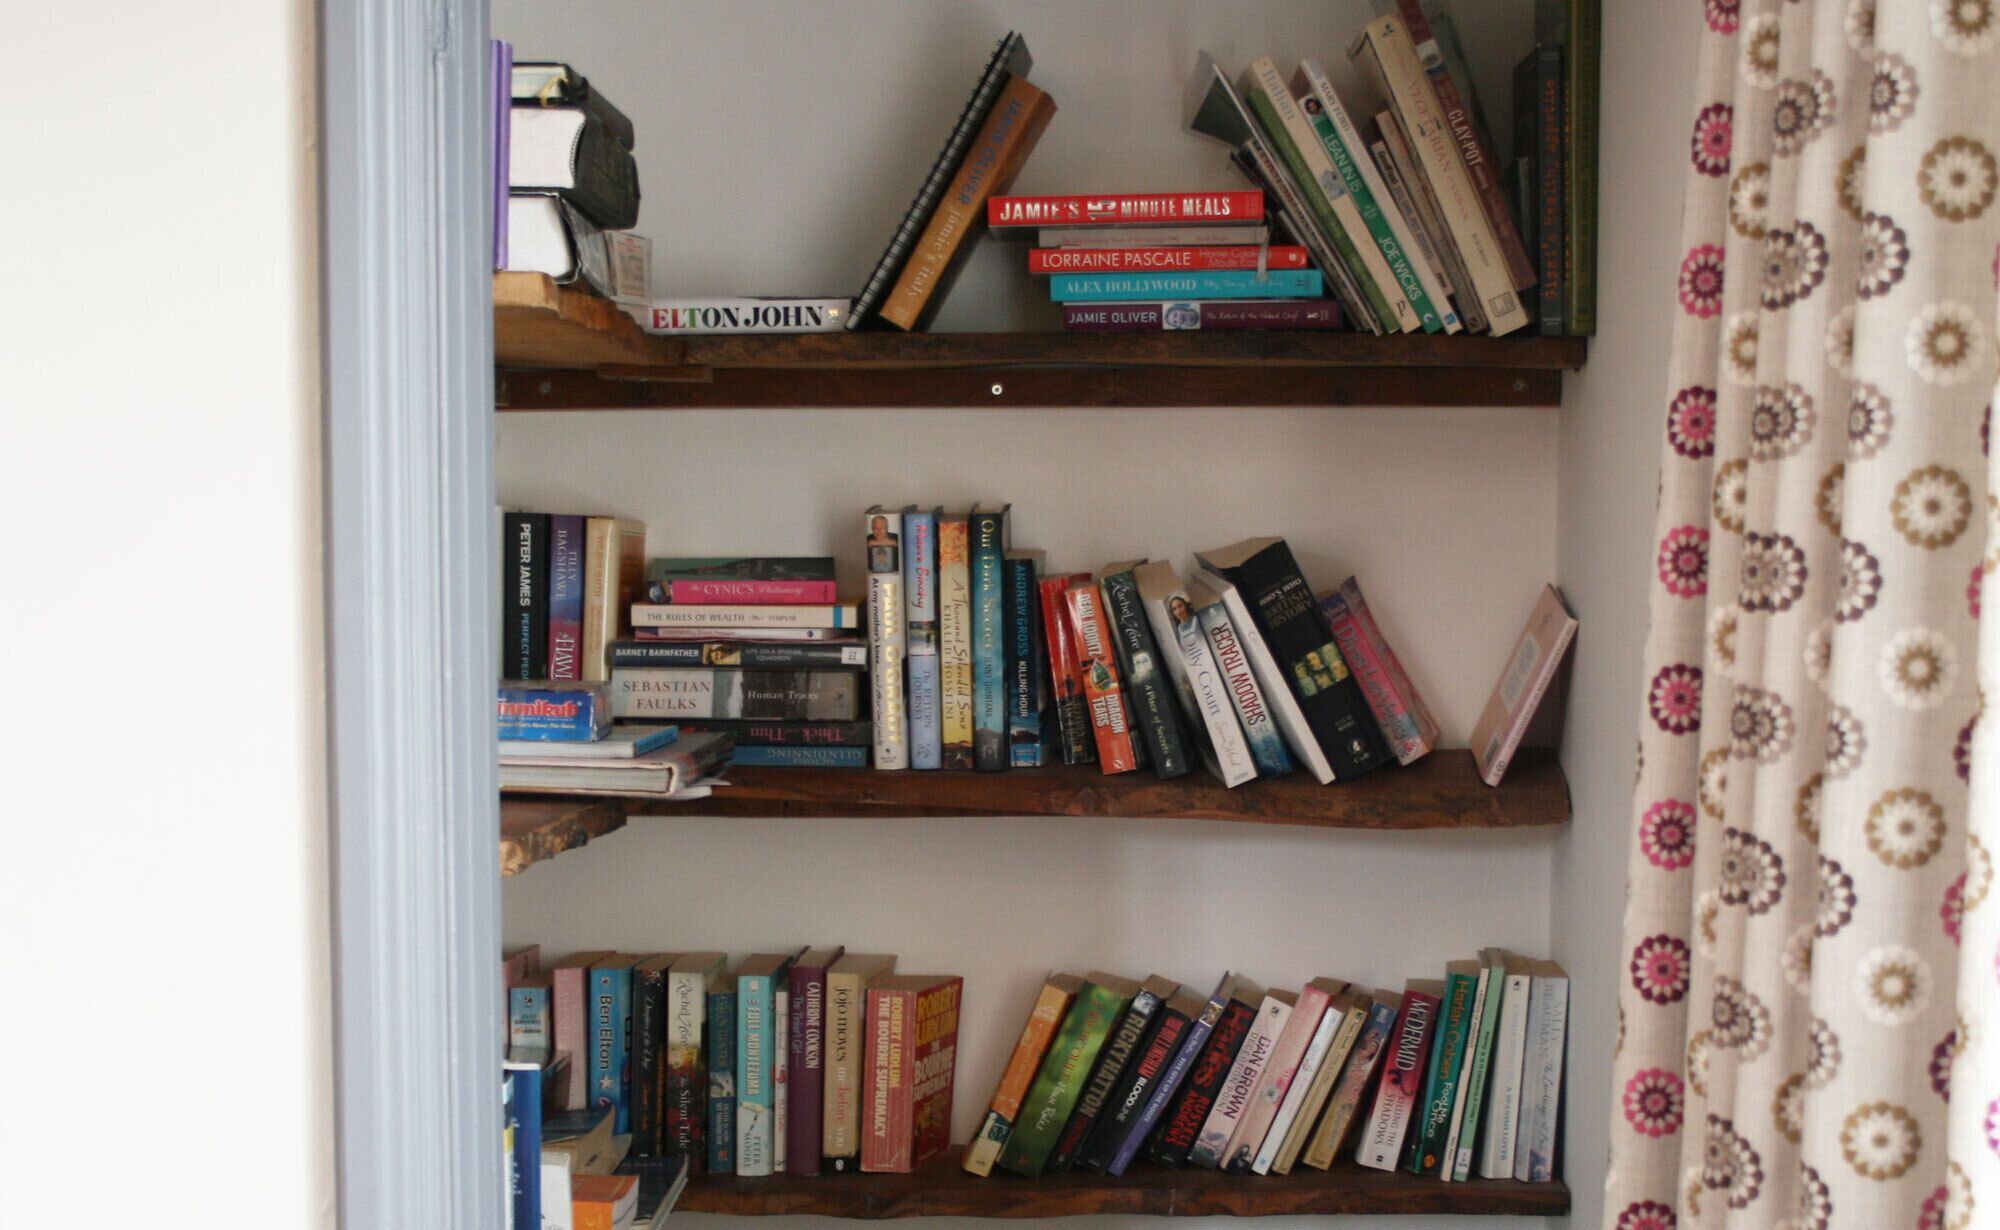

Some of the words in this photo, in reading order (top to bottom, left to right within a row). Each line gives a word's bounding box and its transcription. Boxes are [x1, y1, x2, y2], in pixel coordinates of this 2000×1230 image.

[1319, 81, 1337, 107] MARY
[1333, 107, 1350, 132] FORD
[1325, 134, 1346, 167] LEAN
[1341, 164, 1355, 181] IN
[1349, 179, 1362, 193] 15
[1000, 202, 1080, 221] JAMIE'S
[1121, 199, 1177, 218] MINUTE
[1183, 197, 1231, 216] MEALS
[1042, 252, 1120, 268] LORRAINE
[1124, 252, 1191, 267] PASCALE
[1208, 259, 1239, 268] Made
[1379, 237, 1398, 261] JOE
[1393, 259, 1422, 301] WICKS
[1065, 281, 1101, 293] ALEX
[1105, 279, 1197, 292] HOLLYWOOD
[652, 307, 740, 329] ELTON
[744, 306, 823, 328] JOHN
[1069, 312, 1107, 324] JAMIE
[1111, 311, 1158, 323] OLIVER
[520, 523, 531, 563] PETER
[915, 524, 928, 563] Maeve
[981, 519, 994, 548] Our
[555, 529, 568, 601] BAGSHAWE
[568, 551, 577, 581] TILLY
[872, 578, 880, 586] At
[952, 578, 964, 591] A
[982, 555, 995, 591] Dark
[520, 565, 531, 607] JAMES
[704, 584, 754, 596] CYNIC'S
[872, 588, 880, 599] my
[914, 565, 929, 609] Binchy
[1015, 565, 1028, 615] ANDREW
[1259, 589, 1282, 606] WHO'S
[1282, 578, 1301, 591] WHO
[1264, 588, 1309, 618] BRITISH
[647, 613, 664, 621] THE
[666, 613, 692, 621] RULES
[694, 613, 706, 621] OF
[709, 613, 745, 621] WEALTH
[872, 601, 881, 642] mother's
[882, 583, 898, 639] PAUL
[943, 605, 951, 656] KHALED
[952, 593, 968, 643] Thousand
[983, 599, 995, 649] Secret
[1268, 600, 1312, 629] HISTORY
[521, 613, 529, 654] PERFECT
[1017, 617, 1029, 656] GROSS
[1082, 619, 1102, 656] KOONTZ
[1211, 622, 1244, 673] TRACER
[615, 649, 647, 658] BARNEY
[649, 649, 699, 658] BARNFATHER
[955, 649, 969, 696] Splendid
[622, 681, 710, 693] SEBASTIAN
[944, 662, 953, 720] HOSSEINI
[1018, 660, 1029, 694] KILLING
[1183, 631, 1203, 667] Dilly
[1198, 671, 1222, 717] Court
[636, 699, 697, 710] FAULKS
[747, 690, 784, 700] Human
[788, 690, 819, 701] Traces
[884, 646, 901, 744] O'GRADY
[913, 675, 923, 721] JOURNEY
[923, 681, 932, 728] RETURN
[1019, 695, 1029, 718] HOUR
[1092, 696, 1110, 728] TEARS
[1105, 693, 1125, 734] DRAGON
[1230, 672, 1266, 726] SHADOW
[750, 727, 786, 741] Thin
[801, 727, 844, 741] Thick
[957, 702, 972, 731] Suns
[767, 748, 863, 759] GLENDINNING
[600, 996, 612, 1024] Ben
[748, 1007, 760, 1029] FULL
[806, 982, 821, 1027] CATHERINE
[833, 986, 848, 1017] jojo
[879, 997, 890, 1018] THE
[890, 997, 903, 1041] ROBERT
[916, 984, 962, 1019] ROBERT
[1448, 980, 1470, 1028] Harlan
[834, 1019, 847, 1062] moyes
[877, 1020, 890, 1067] BOURNE
[916, 1008, 960, 1047] LUDLUM
[1110, 1013, 1147, 1062] RICKY
[1194, 1003, 1255, 1088] Hades
[1394, 997, 1431, 1071] McDERMID
[600, 1028, 612, 1070] Elton
[747, 1034, 761, 1095] MONTEZUMA
[805, 1029, 820, 1069] COOKSON
[889, 1043, 902, 1088] LUDLUM
[914, 1045, 955, 1083] BOURNE
[1138, 1027, 1178, 1079] BILLINGHAM
[1228, 1033, 1260, 1083] DECEPTION
[1250, 1036, 1272, 1067] DAN
[1440, 1030, 1460, 1079] Coben
[836, 1066, 847, 1085] me
[1079, 1058, 1122, 1117] HATTON
[1224, 1064, 1258, 1120] BROWN
[1442, 1082, 1454, 1107] Fool
[680, 1089, 691, 1120] Silent
[836, 1087, 849, 1122] before
[874, 1069, 888, 1137] SUPREMACY
[1116, 1076, 1147, 1122] BLOODLINE
[1165, 1089, 1199, 1143] ANDREWS
[1216, 1086, 1234, 1115] POINT
[680, 1125, 691, 1149] Tide
[1035, 1108, 1056, 1131] Rules
[1177, 1095, 1211, 1148] RUSSELL
[1374, 1093, 1391, 1145] SHADOWS
[1427, 1100, 1440, 1138] Once
[744, 1132, 752, 1167] MOORE
[753, 1136, 761, 1168] PETER
